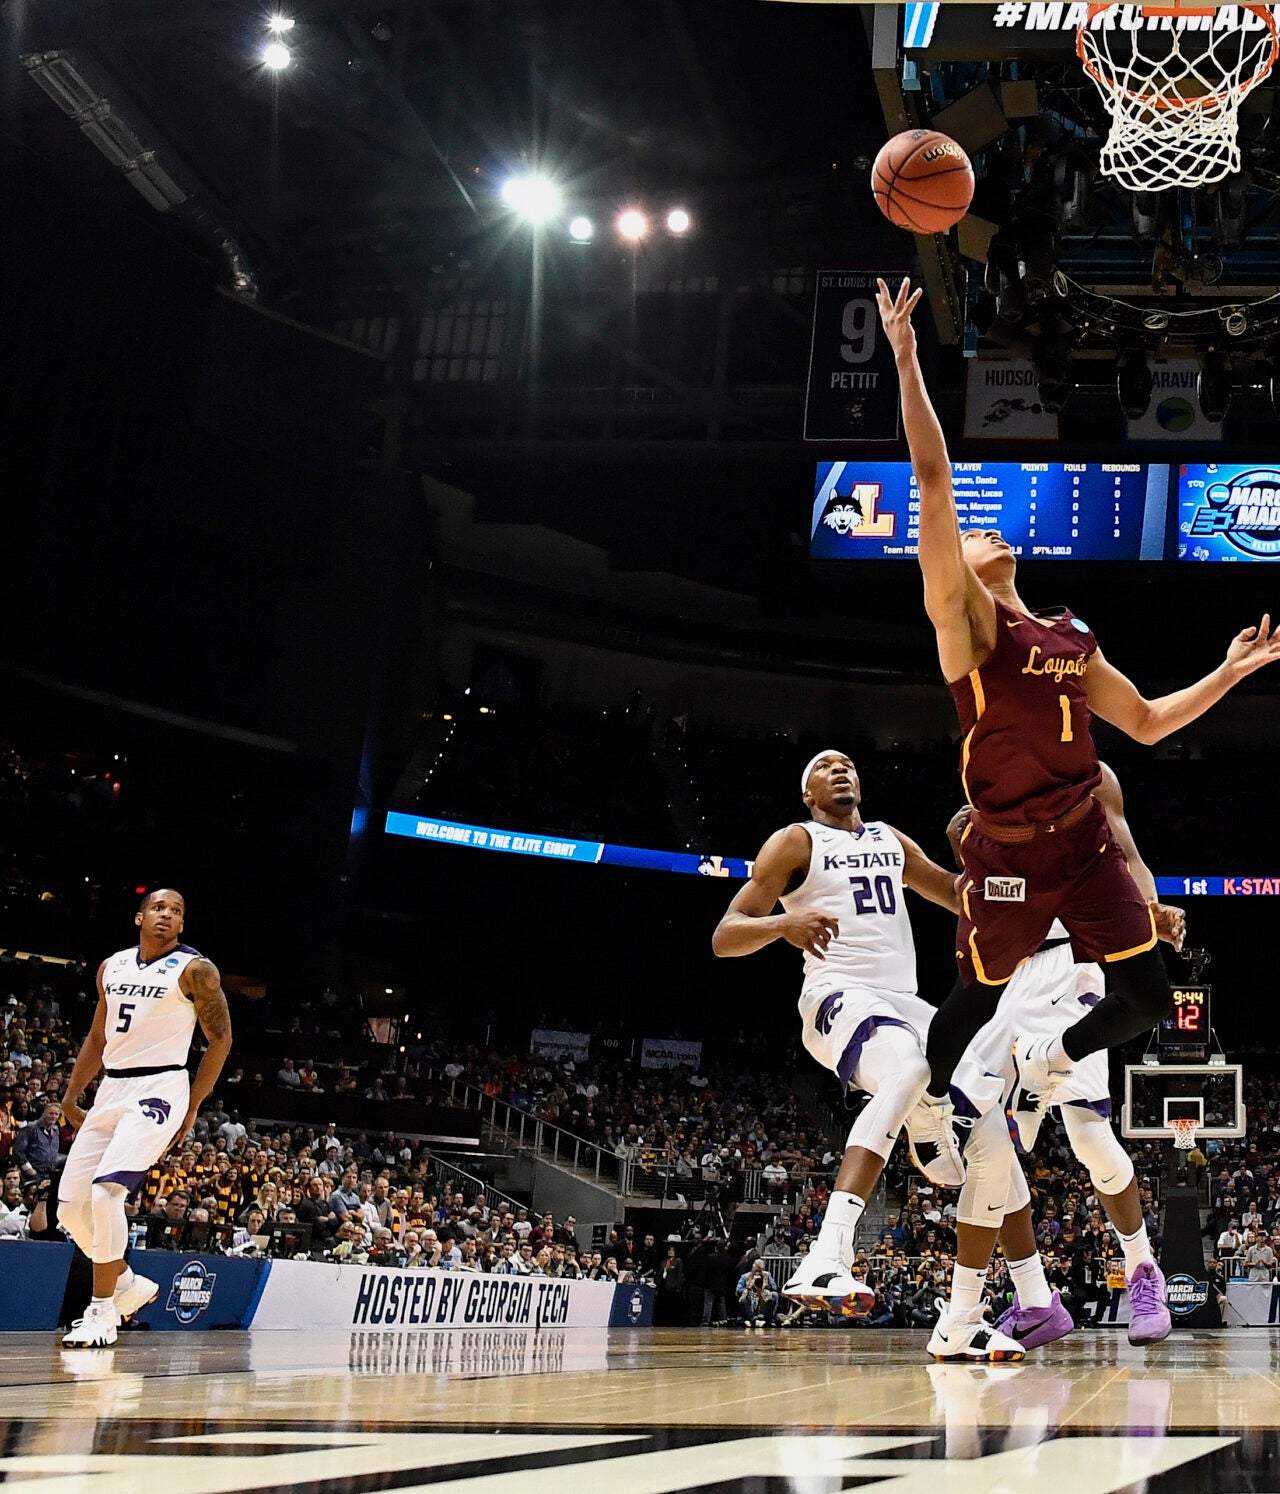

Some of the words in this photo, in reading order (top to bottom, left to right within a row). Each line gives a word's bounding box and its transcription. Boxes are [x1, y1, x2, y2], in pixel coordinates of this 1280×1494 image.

[840, 298, 877, 364] 9
[831, 372, 880, 390] PETTIT
[985, 370, 1038, 387] HUDSO
[1059, 694, 1074, 742] 1
[416, 822, 472, 843] WELCOME
[472, 831, 488, 846] TO
[489, 834, 512, 849] THE
[512, 837, 542, 853] ELITE
[542, 840, 576, 857] EIGHT
[824, 852, 902, 872] K-STATE
[848, 874, 896, 916] 20
[988, 880, 1024, 898] VALLEY
[1184, 878, 1208, 895] 1st
[105, 983, 168, 998] K-STATE
[1173, 990, 1204, 1006] 9:44
[116, 1002, 136, 1034] 5
[1178, 1006, 1200, 1030] 12
[180, 1277, 204, 1290] MARCH
[1167, 1284, 1194, 1294] MARCH
[180, 1290, 212, 1304] MADNESS
[352, 1274, 437, 1324] HOSTED
[436, 1278, 464, 1324] BY
[464, 1280, 534, 1324] GEORGIA
[536, 1284, 570, 1324] TECH
[1169, 1292, 1206, 1302] MADNESS
